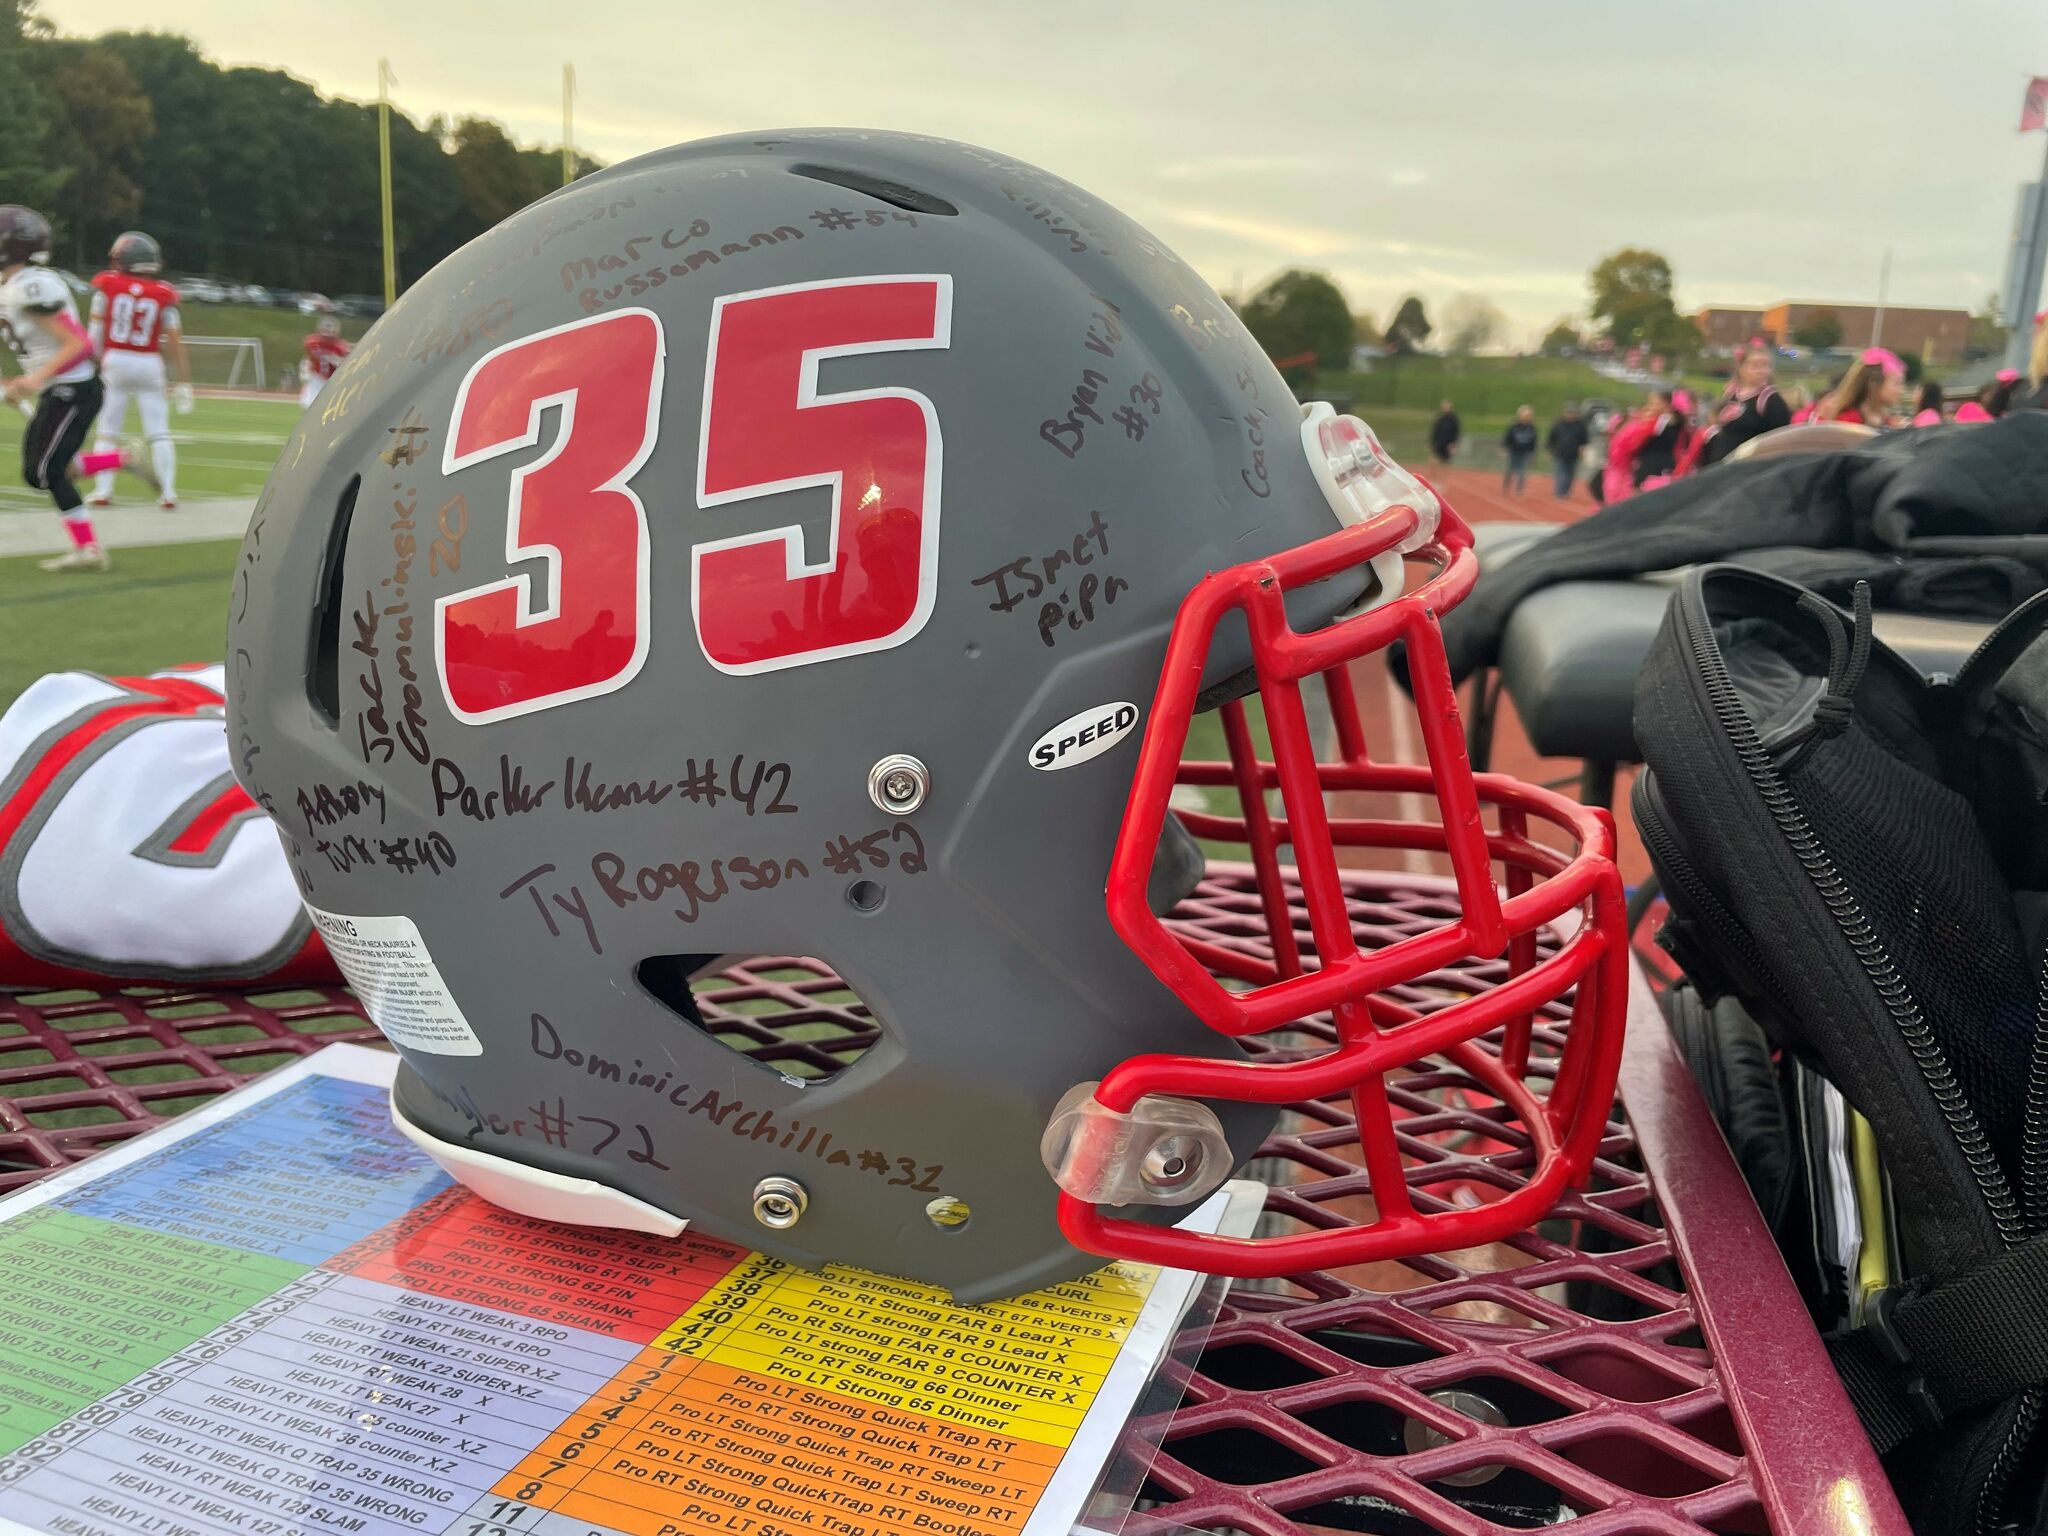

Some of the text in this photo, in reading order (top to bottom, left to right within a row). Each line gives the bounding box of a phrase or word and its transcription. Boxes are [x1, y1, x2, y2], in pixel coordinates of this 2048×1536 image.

[109, 292, 160, 347] 83
[433, 274, 955, 724] 35
[1034, 704, 1136, 768] SPEED
[432, 754, 555, 821] Parker
[500, 863, 603, 956] Ty
[591, 852, 809, 923] Rogerson
[463, 1239, 656, 1287] PRO RT STRONG 61 FIN
[468, 1224, 504, 1238] PRO
[506, 1232, 530, 1243] LT
[528, 1238, 605, 1259] STRONG
[625, 1257, 666, 1271] SLIP
[666, 1266, 682, 1276] X
[395, 1294, 569, 1342] HEAVY LT WEAK 3 RPO
[406, 1260, 639, 1319] PRO RT STRONG 66 SHANK
[818, 1285, 1076, 1347] Pro Rt Strong FAR 8 Lead X
[326, 1316, 562, 1384] HEAVY LT WEAK 21 SUPER X,Z
[665, 1337, 703, 1356] 42
[766, 1307, 1085, 1386] Pro Rt Strong FAR 8 COUNTER X
[1010, 1313, 1118, 1340] 67 R-VERTS X
[132, 1371, 175, 1392] 78
[300, 1330, 544, 1400] HEAVY RT WEAK 22 SUPER X,Z
[755, 1322, 1078, 1405] Pro LT strong FAR 9 COUNTER X
[766, 1361, 1010, 1430] Pro LT Strong 65 Dinner
[780, 1346, 1022, 1412] Pro RT Strong 66 Dinner
[717, 1392, 1006, 1473] Pro RT Strong Quick Trap LT
[733, 1375, 1017, 1453] Pro LT Strong Quick Trap RT
[155, 1407, 455, 1504] HEAVY RT WEAK Q TRAP 35 WRONG
[649, 1420, 1017, 1522] Pro RT Strong Quick Trap LT Sweep RT
[669, 1403, 1028, 1501] Pro LT Strong Quick Trap RT Sweep LT
